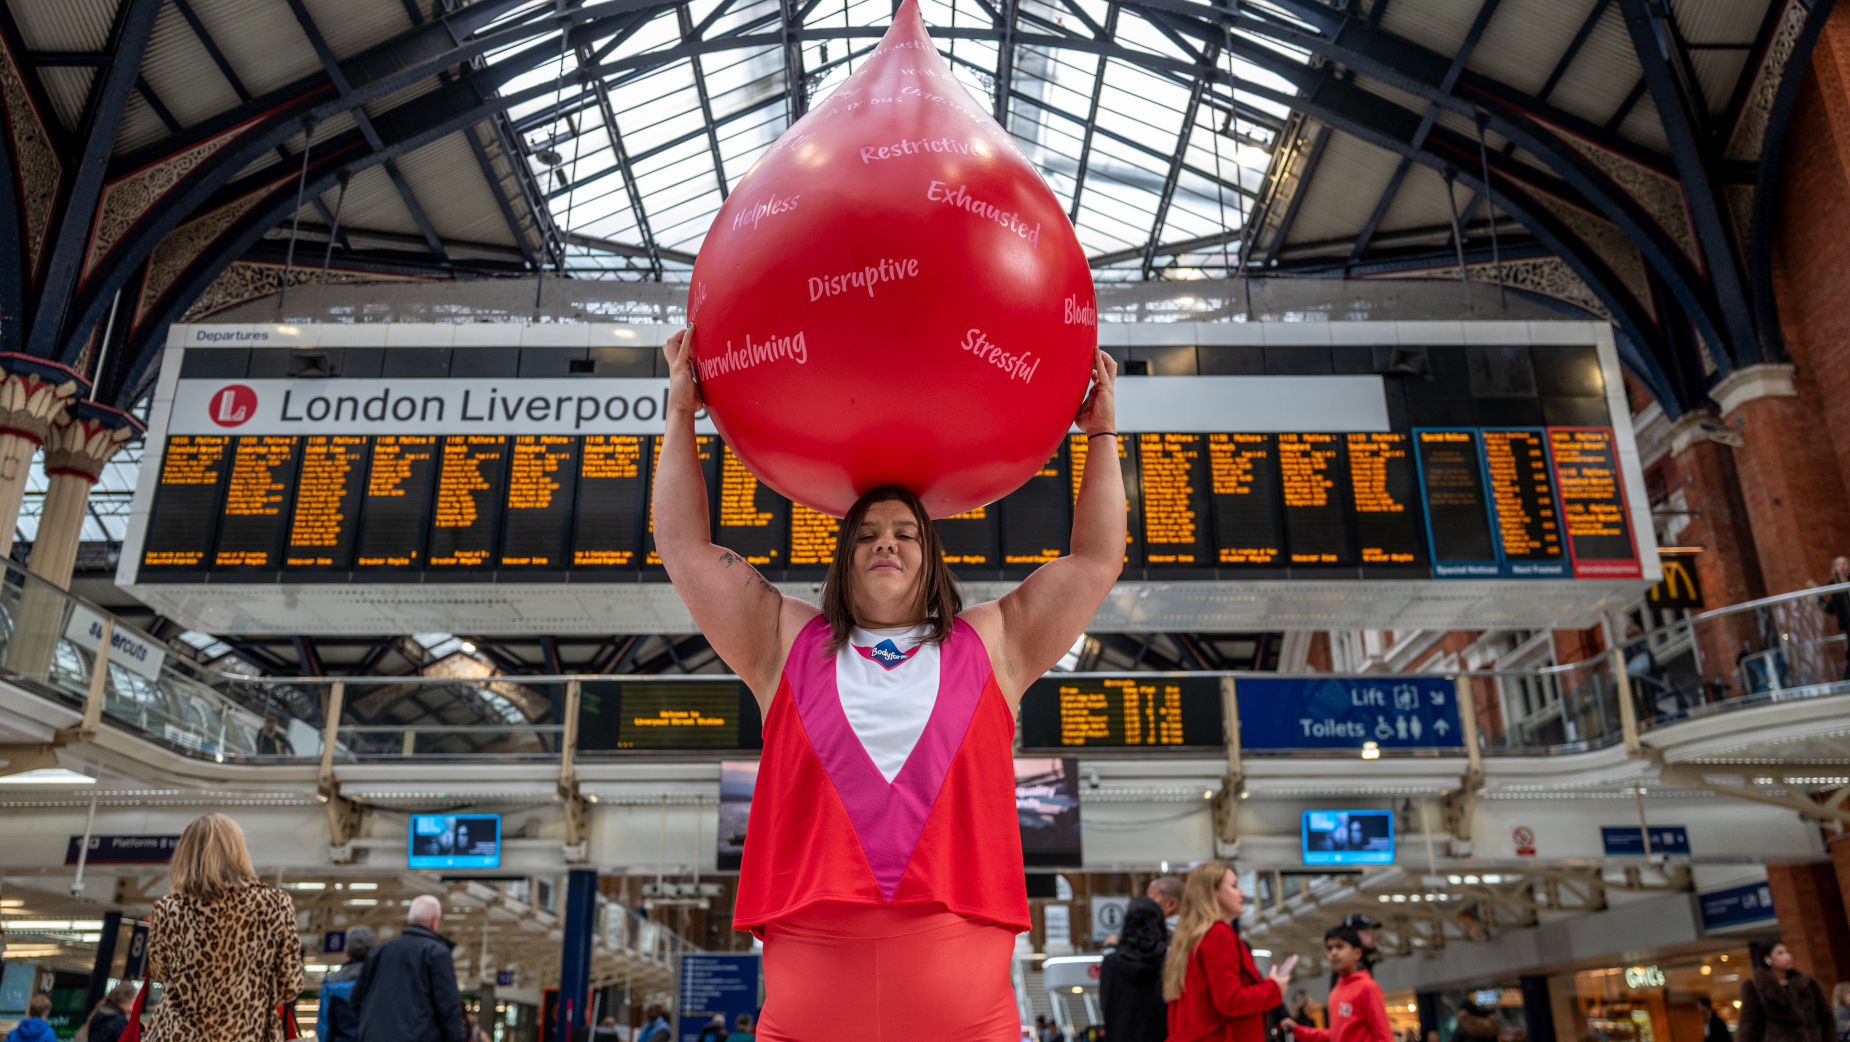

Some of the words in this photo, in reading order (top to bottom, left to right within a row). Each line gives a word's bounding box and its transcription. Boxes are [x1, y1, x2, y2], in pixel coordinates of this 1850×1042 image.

[860, 138, 983, 164] Restrictive
[732, 189, 800, 231] Helpless
[926, 180, 1041, 250] Exhausted
[807, 257, 919, 302] Disruptive
[196, 329, 269, 342] Departures
[697, 330, 808, 382] Overwhelming
[960, 328, 1041, 384] Stressful
[281, 389, 445, 421] London
[461, 388, 669, 430] Liverpool
[1421, 432, 1444, 442] Special
[88, 620, 148, 663] suercuts
[871, 647, 909, 660] Bodyform
[1352, 688, 1386, 706] Lift
[1300, 718, 1365, 737] Toilets
[112, 838, 158, 848] Platforms
[131, 933, 144, 958] 8
[41, 971, 55, 993] 10
